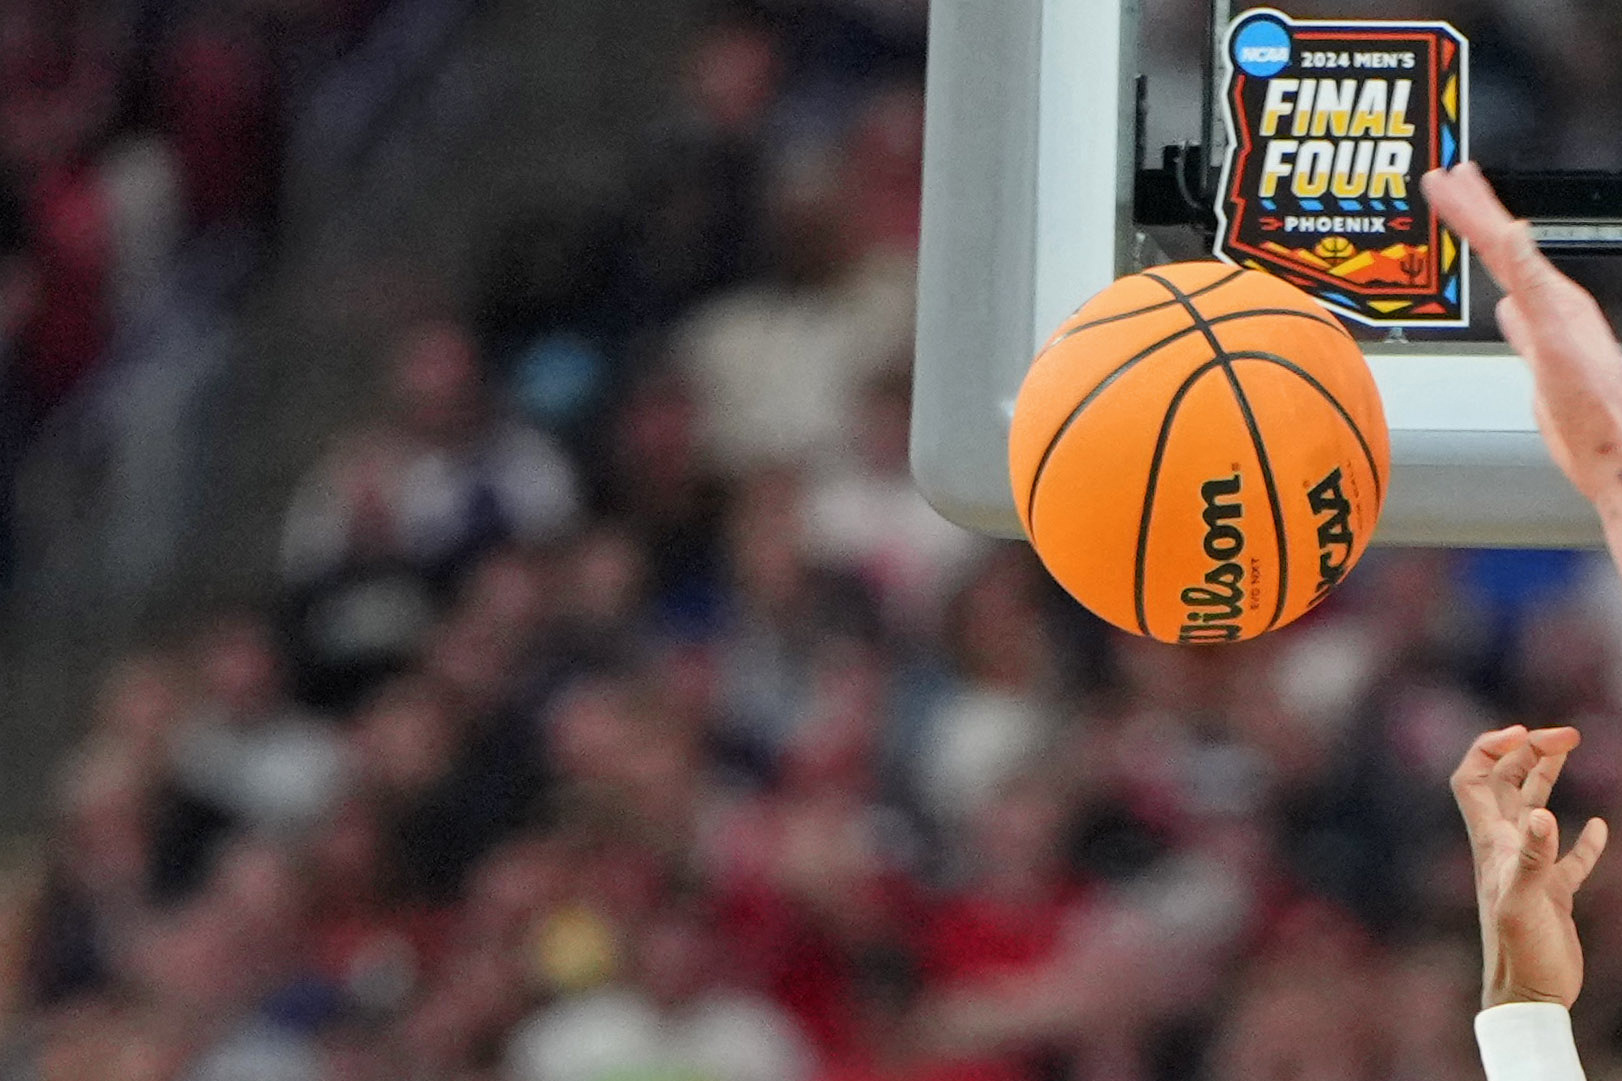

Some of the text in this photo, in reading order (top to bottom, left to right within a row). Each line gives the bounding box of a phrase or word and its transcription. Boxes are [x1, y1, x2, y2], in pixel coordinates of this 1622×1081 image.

[1301, 52, 1416, 68] 2024 MEN'S
[1259, 78, 1416, 138] FINAL
[1258, 140, 1414, 199] FOUR
[1284, 216, 1386, 233] PHOENIX
